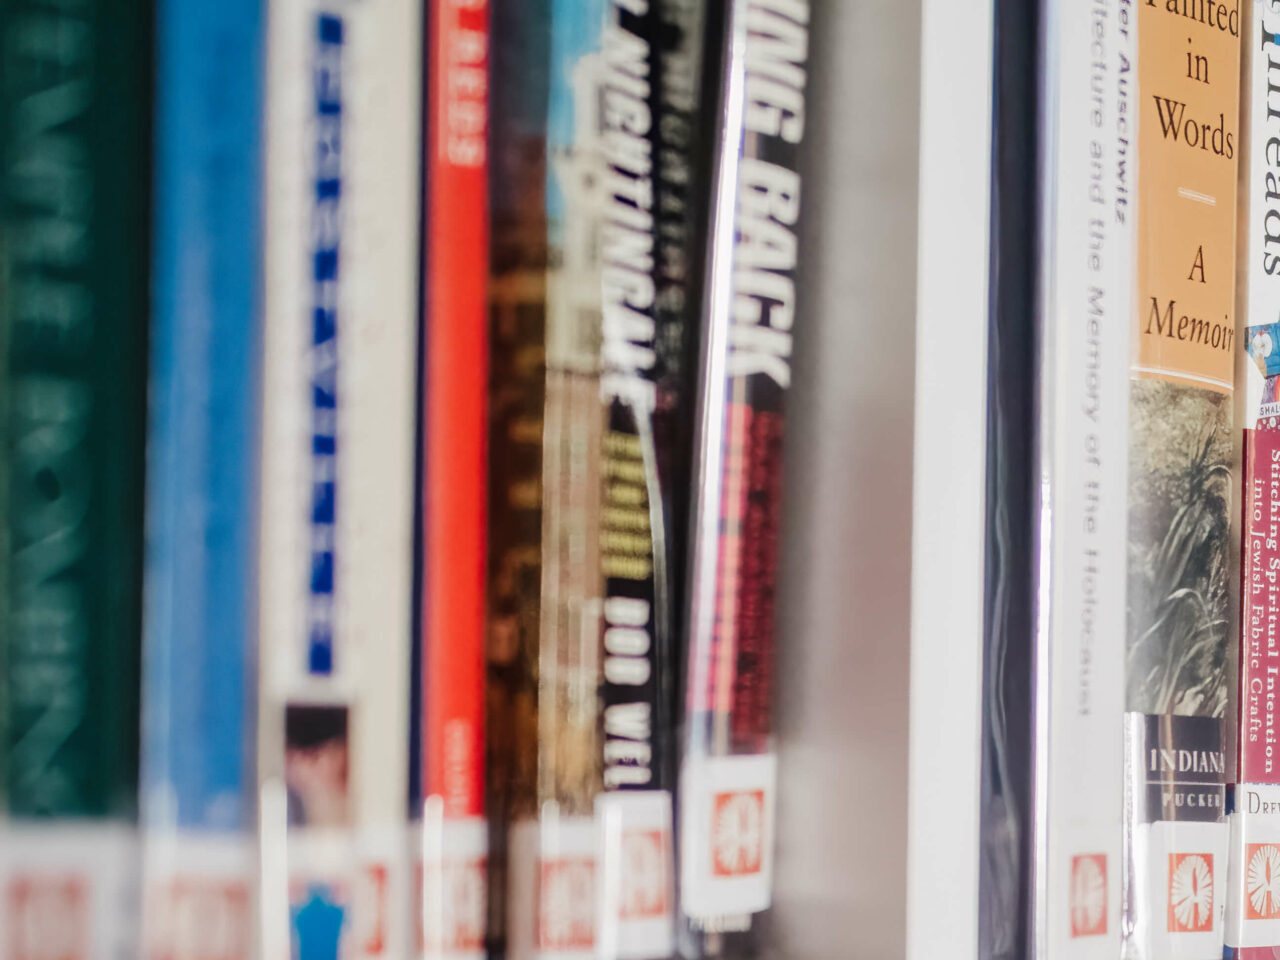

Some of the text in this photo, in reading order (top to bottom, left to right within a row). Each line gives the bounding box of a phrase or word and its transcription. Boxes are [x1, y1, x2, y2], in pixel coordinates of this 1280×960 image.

[1145, 0, 1239, 38] ainted
[1186, 37, 1210, 85] in
[1115, 52, 1131, 225] Auschwitz
[1152, 94, 1234, 160] Words
[1088, 139, 1106, 205] and
[726, 156, 802, 390] BACK
[1088, 218, 1105, 271] the
[1187, 244, 1207, 284] A
[1081, 286, 1106, 424] Memory
[1143, 296, 1235, 353] Memoir
[1250, 477, 1265, 743] into Jewish Fabric Crafts
[1265, 557, 1280, 658] Spiritual
[1265, 667, 1279, 774] Intention
[1150, 748, 1225, 774] INDIANA
